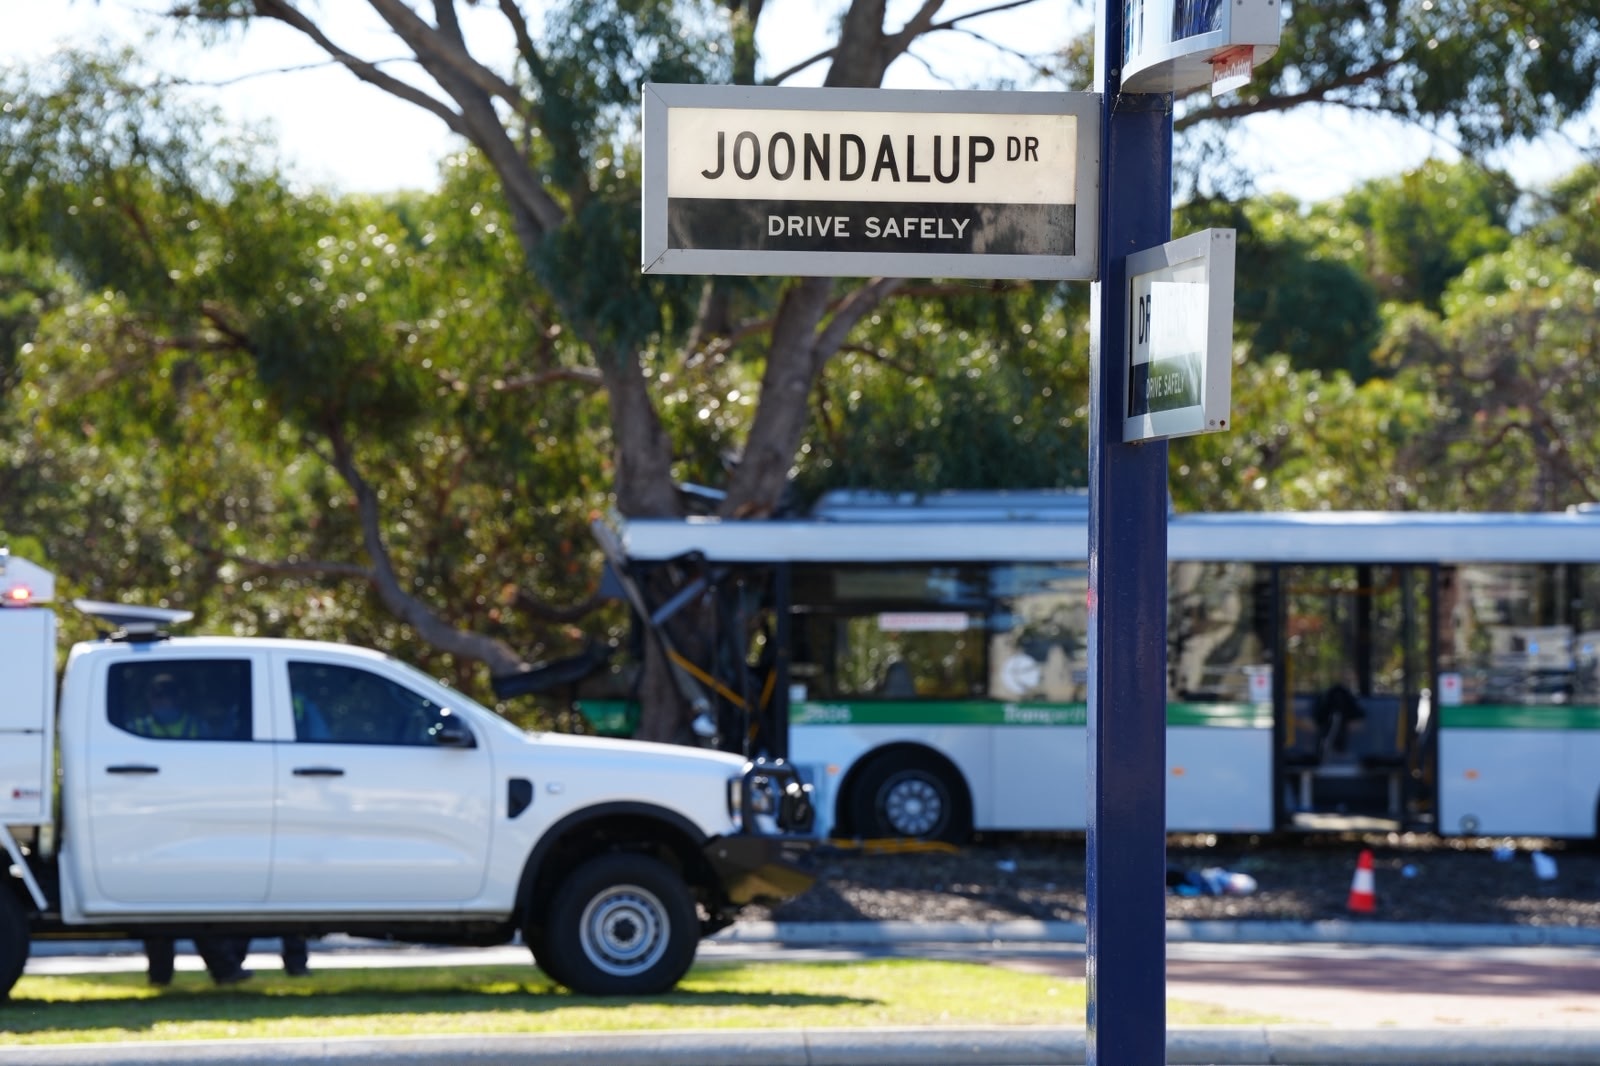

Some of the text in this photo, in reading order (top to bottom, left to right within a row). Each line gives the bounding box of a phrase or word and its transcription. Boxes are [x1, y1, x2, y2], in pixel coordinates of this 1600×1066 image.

[701, 131, 1039, 183] JOONDALUP DR
[768, 215, 970, 239] DRIVE SAFELY
[1146, 371, 1184, 399] DRIVE SAFELY
